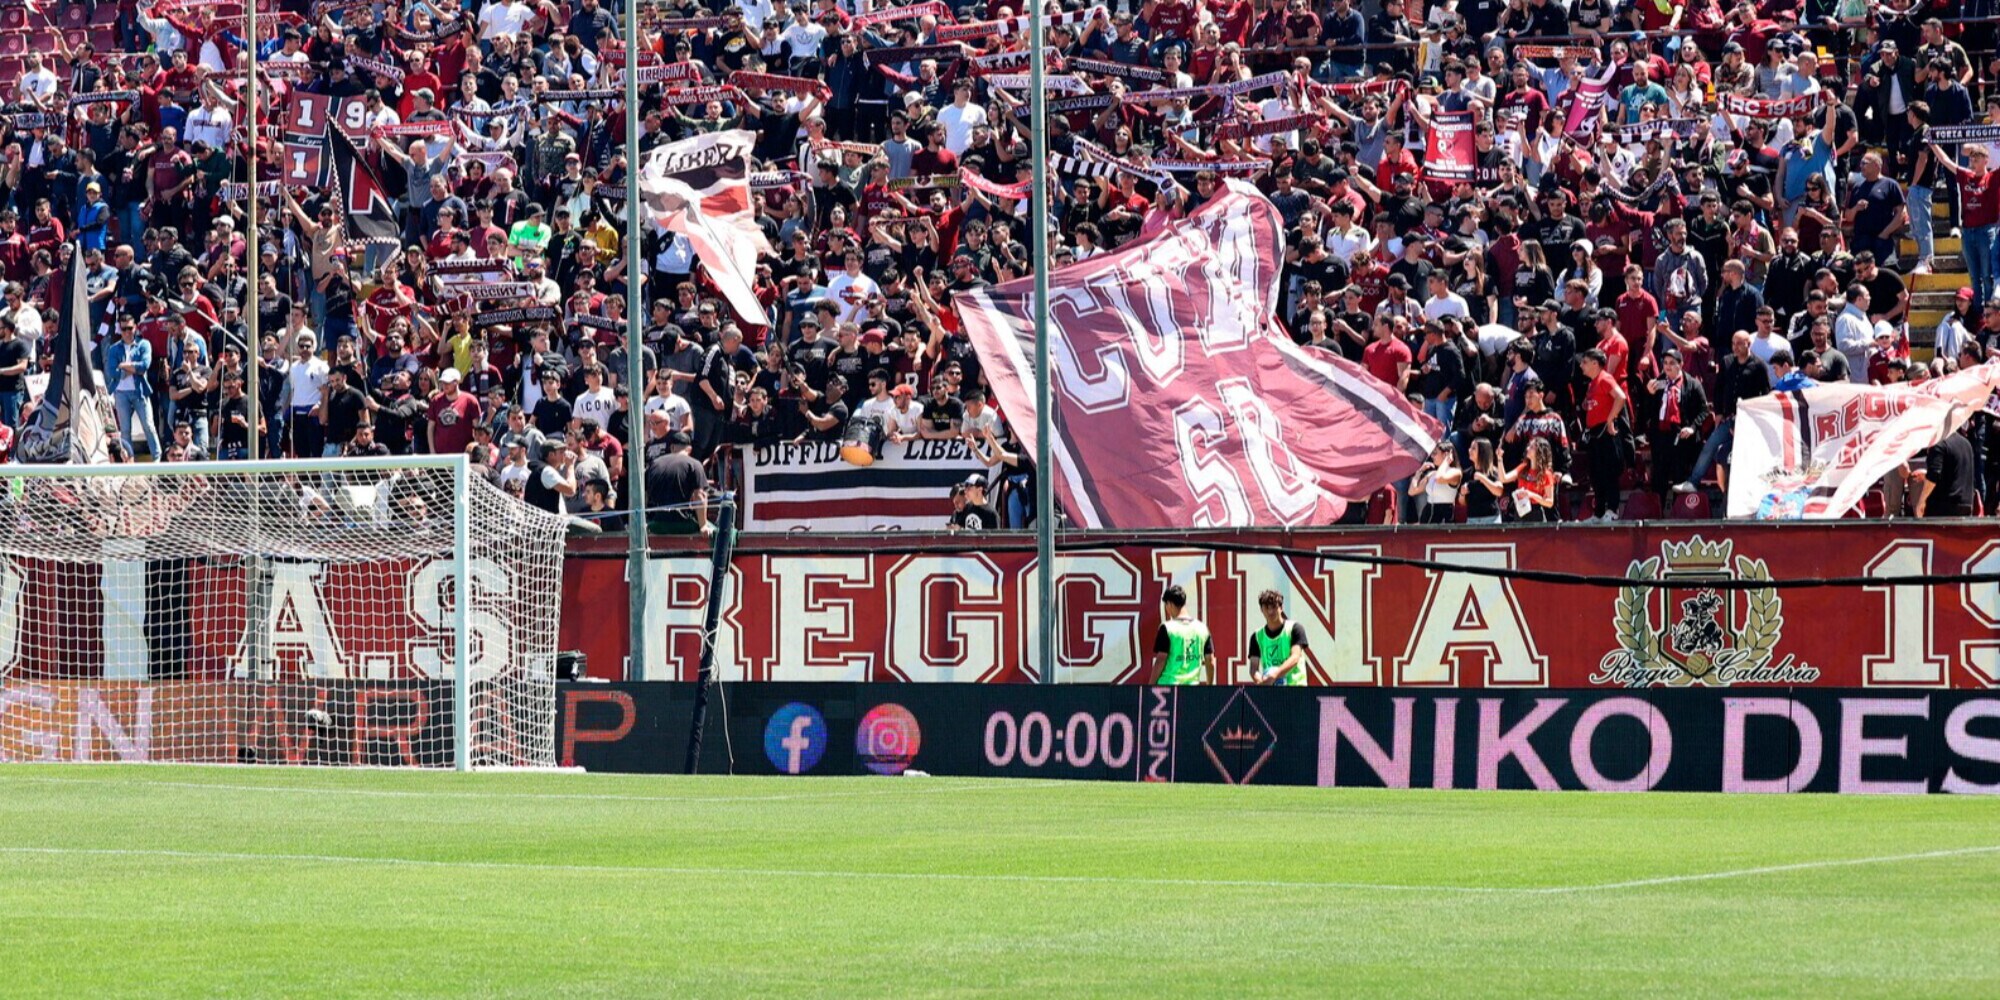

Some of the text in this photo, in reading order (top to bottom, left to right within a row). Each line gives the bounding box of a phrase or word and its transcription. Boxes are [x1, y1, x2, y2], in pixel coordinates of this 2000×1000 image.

[297, 98, 365, 129] 1 9
[1729, 96, 1808, 116] RC 1914
[1965, 127, 2000, 138] REGGIN
[290, 150, 308, 178] 1
[580, 399, 612, 414] ICON
[623, 542, 1550, 690] REGGINA
[1590, 650, 1820, 688] Reggio Calabria
[983, 710, 1136, 768] 00:00
[1147, 686, 1171, 783] NGM
[1316, 694, 2000, 795] NIKO DES
